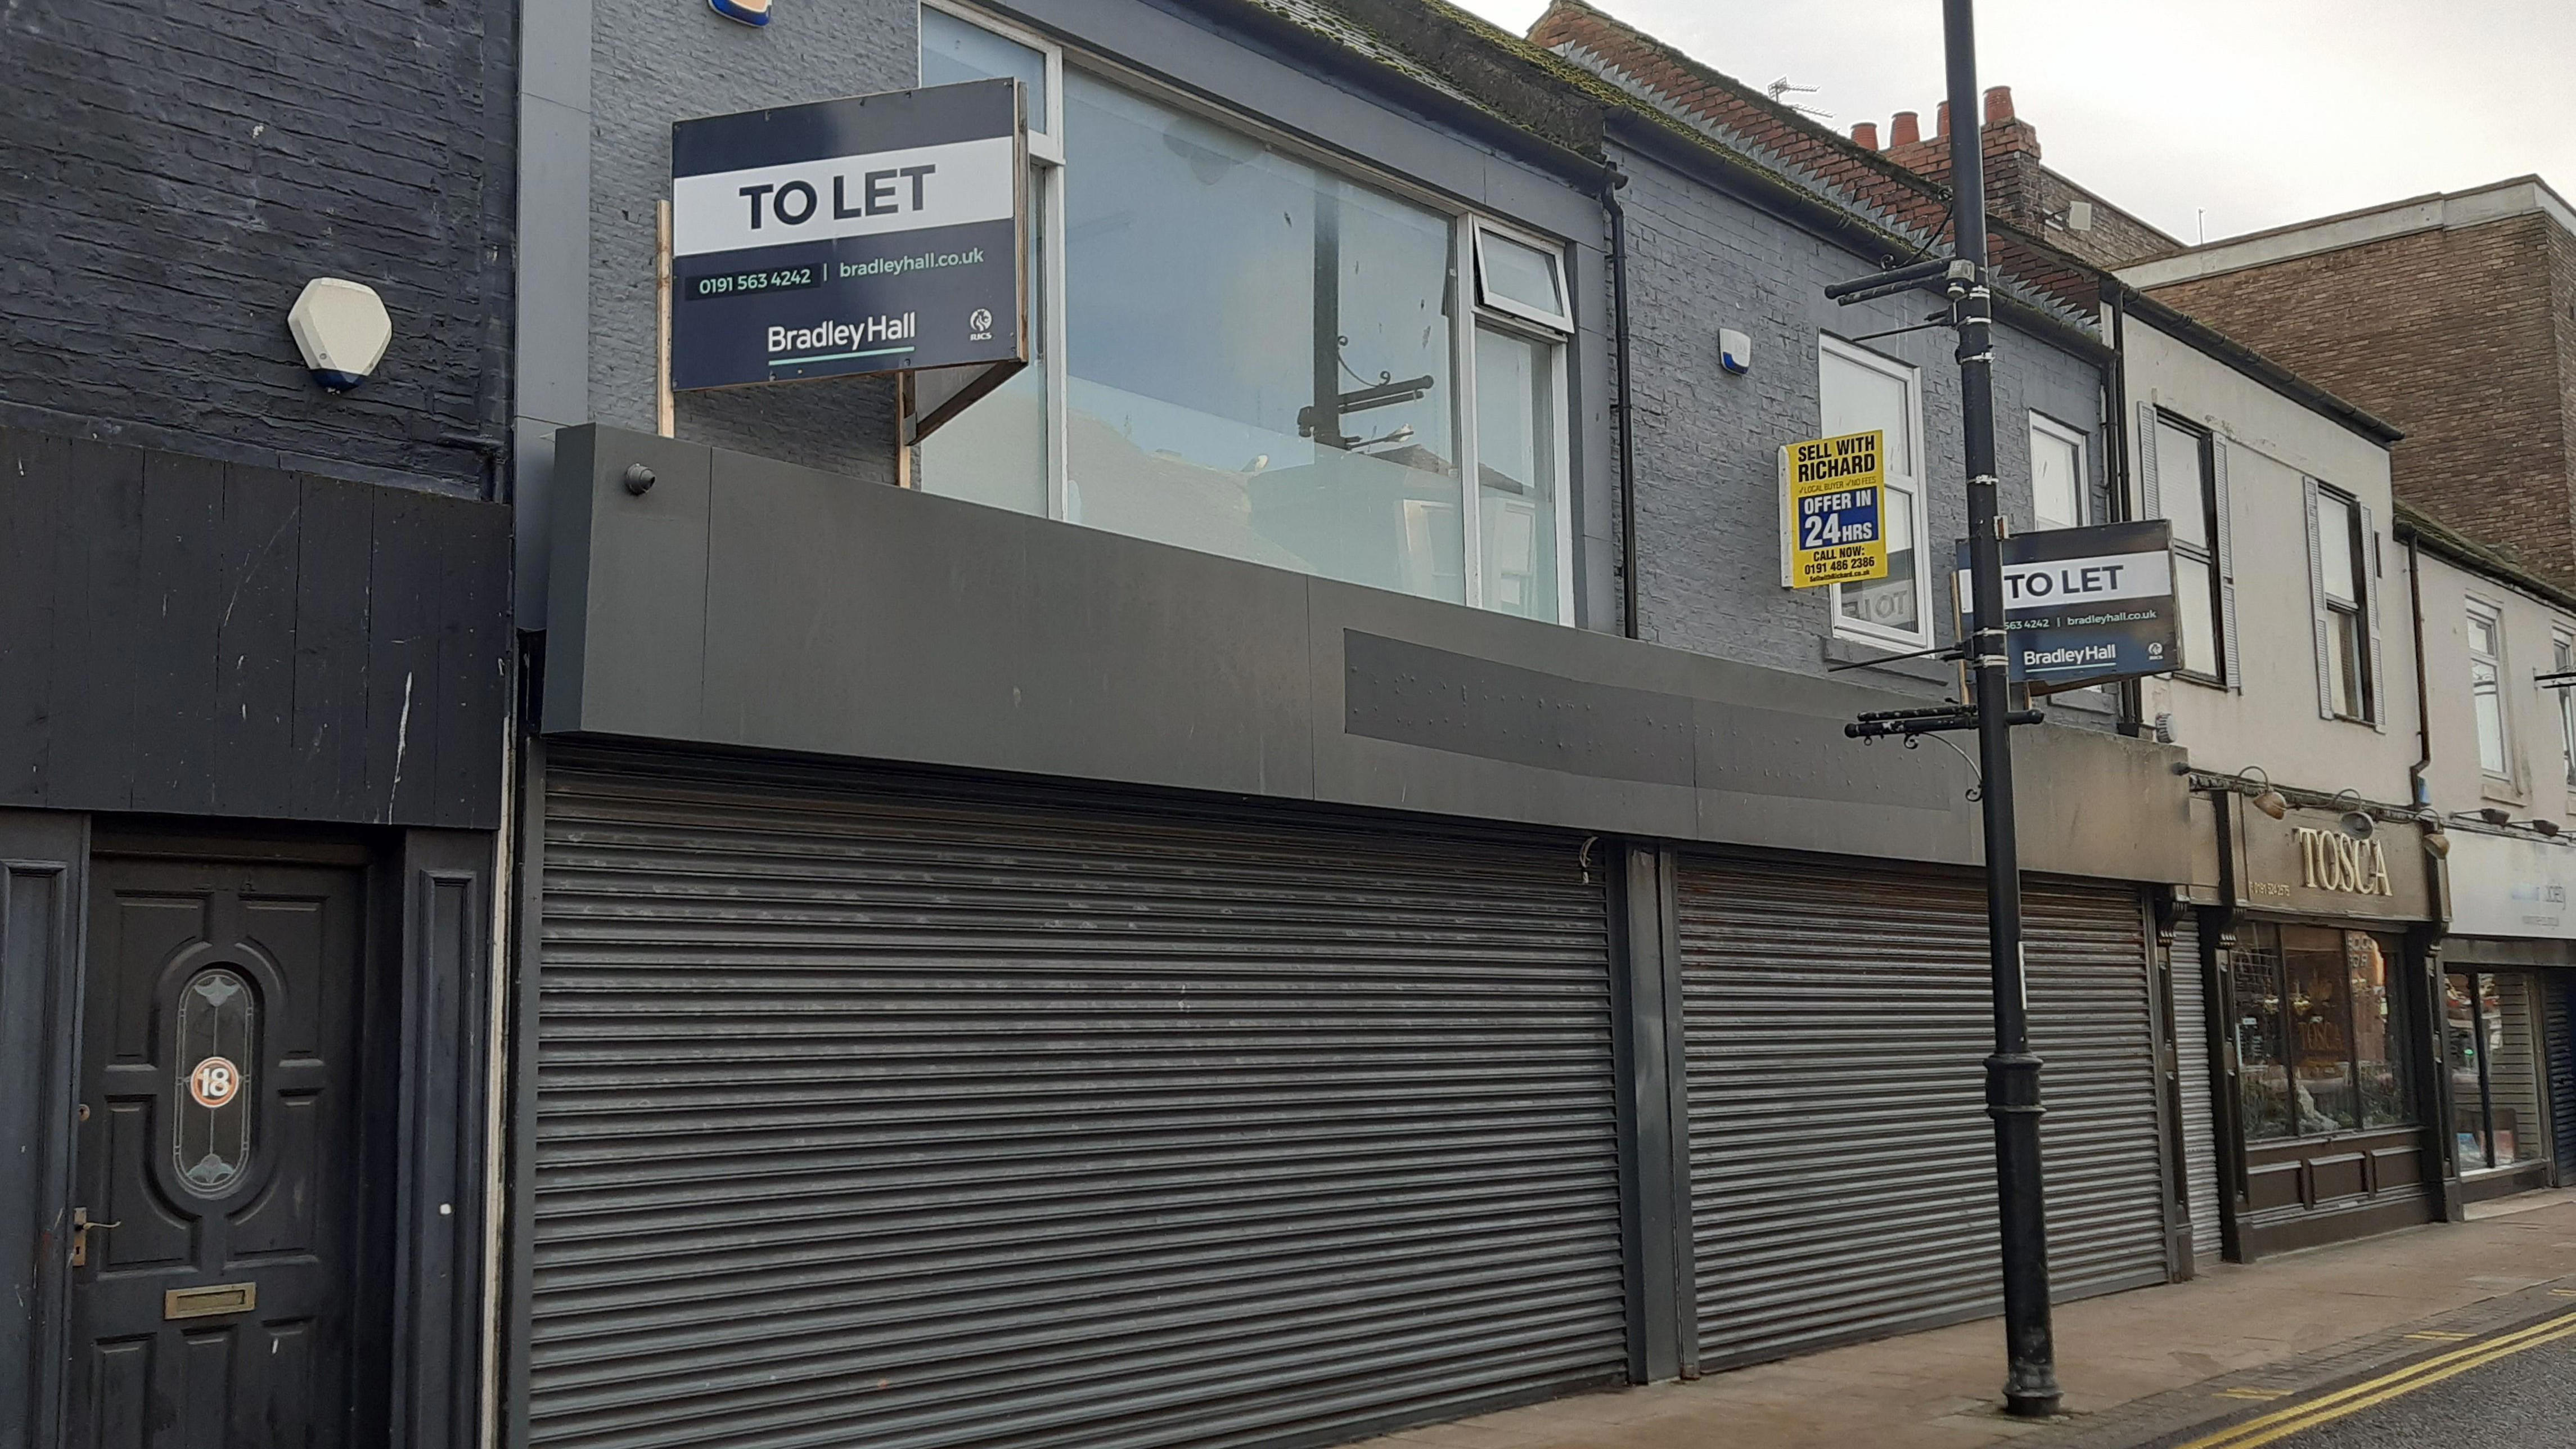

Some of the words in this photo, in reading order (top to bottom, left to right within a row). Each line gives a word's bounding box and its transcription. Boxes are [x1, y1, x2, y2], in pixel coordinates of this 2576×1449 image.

[739, 180, 817, 230] TO
[833, 164, 936, 220] LET
[699, 277, 733, 294] 0191
[737, 273, 768, 290] 563
[771, 268, 811, 286] 4242
[839, 248, 984, 278] bradleyhall.co.uk
[767, 320, 864, 352] Bradley
[867, 312, 916, 341] Hall
[1798, 443, 1832, 462] SELL
[1836, 435, 1875, 456] WITH
[1798, 453, 1875, 482] RICHARD
[1824, 482, 1843, 490] BUYER
[1862, 476, 1876, 485] FEES
[1804, 492, 1852, 515] OFFER
[1856, 489, 1871, 507] IN
[1804, 512, 1841, 547] 24
[1842, 522, 1872, 542] HRS
[1804, 562, 1826, 574] 0191
[1830, 560, 1848, 571] 486
[1851, 556, 1875, 569] 2386
[1813, 549, 1836, 561] CALL
[1839, 546, 1865, 558] NOW:
[2004, 572, 2053, 598] TO
[2062, 565, 2124, 594] LET
[2024, 619, 2050, 628] 4242
[2067, 610, 2156, 626] bradleyhall.co.uk
[2024, 646, 2084, 666] Bradley
[2086, 644, 2115, 660] Hall
[2297, 827, 2393, 897] TOSCA
[203, 1068, 229, 1096] 18
